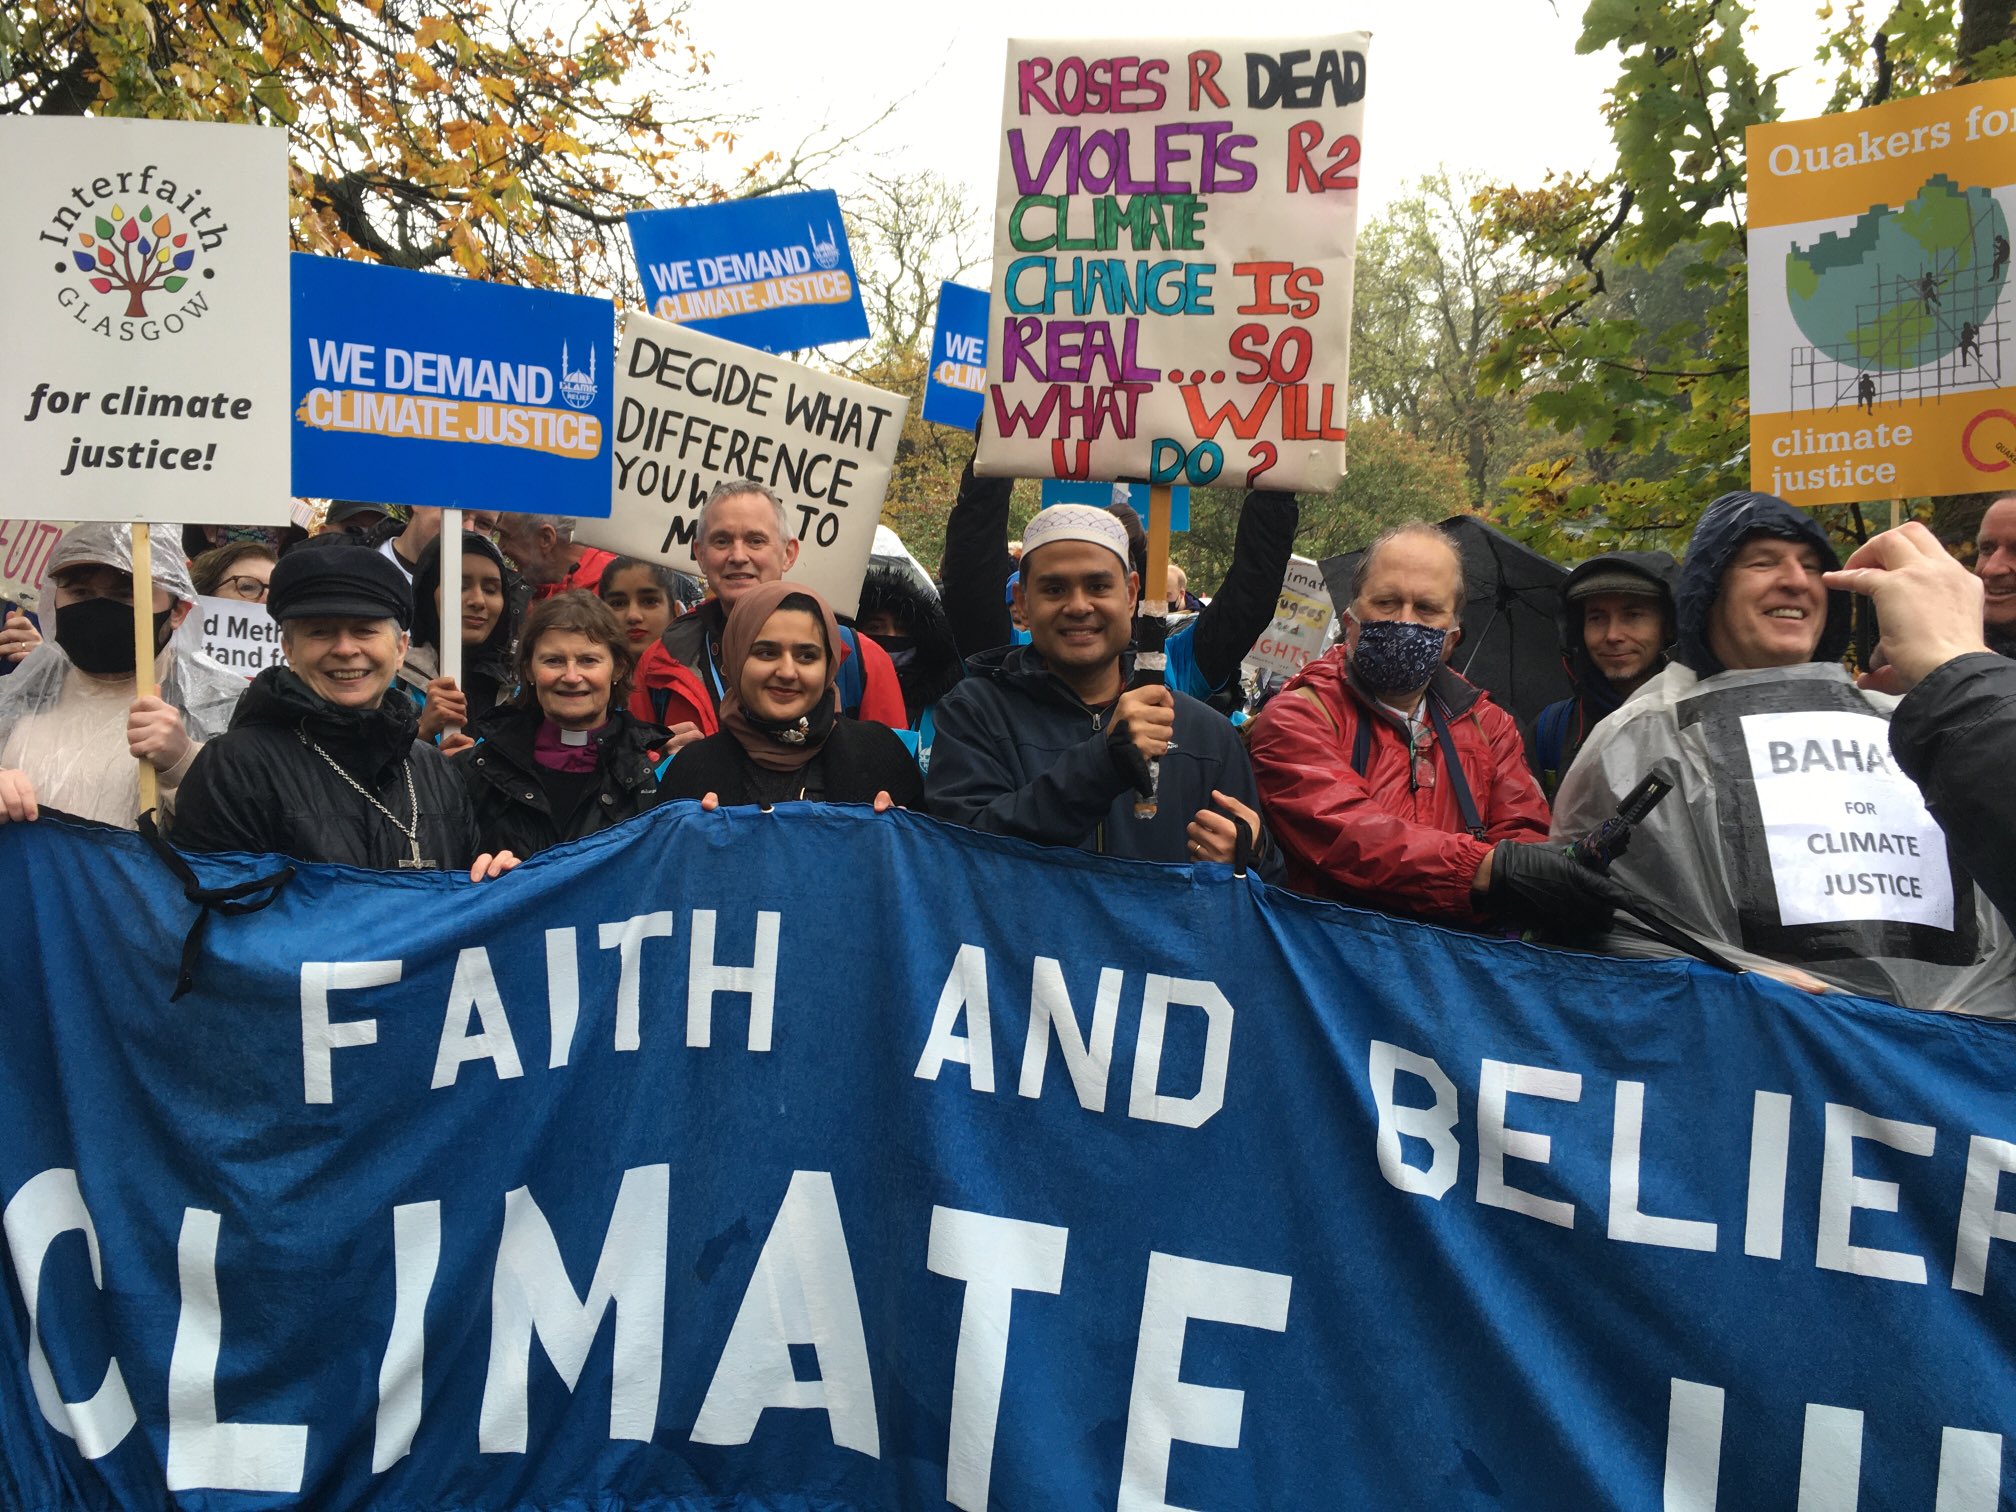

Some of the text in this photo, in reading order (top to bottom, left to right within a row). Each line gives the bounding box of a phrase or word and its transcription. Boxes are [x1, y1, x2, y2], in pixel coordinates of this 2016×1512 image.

[1018, 49, 1366, 116] ROSES R DEAD
[1007, 120, 1361, 196] VIOLETS R2
[1768, 121, 1950, 177] Quakers
[39, 165, 229, 253] Interfaith
[1009, 193, 1208, 251] CLIMATE
[649, 260, 696, 292] WE
[697, 245, 811, 287] DEMAND
[1005, 256, 1323, 319] CHANGE IS
[57, 287, 208, 341] GLASGOW
[658, 271, 849, 321] CLIMATE JUSTICE
[308, 338, 553, 405] WE DEMAND
[945, 331, 984, 364] WE
[1229, 323, 1313, 385] SO
[24, 383, 253, 421] for climate
[307, 387, 598, 452] CLIMATE JUSTICE
[627, 337, 892, 451] DECIDE WHAT
[990, 382, 1347, 442] WHAT WILL
[60, 436, 217, 477] justice!
[616, 396, 858, 508] DIFFERENCE
[1051, 438, 1278, 489] U DO ?
[1771, 423, 1913, 458] climate
[614, 450, 686, 503] YOU
[1771, 460, 1896, 498] justice
[796, 504, 839, 547] TO
[1287, 568, 1327, 592] imat
[203, 613, 218, 636] d
[204, 642, 262, 668] tand
[1768, 739, 1893, 775] BAHA
[1844, 801, 1877, 816] FOR
[1807, 832, 1921, 857] CLIMATE
[1824, 873, 1923, 899] JUSTICE
[301, 908, 781, 1105] FAITH
[914, 943, 1235, 1129] AND
[3, 1163, 1293, 1512] CLIMATE
